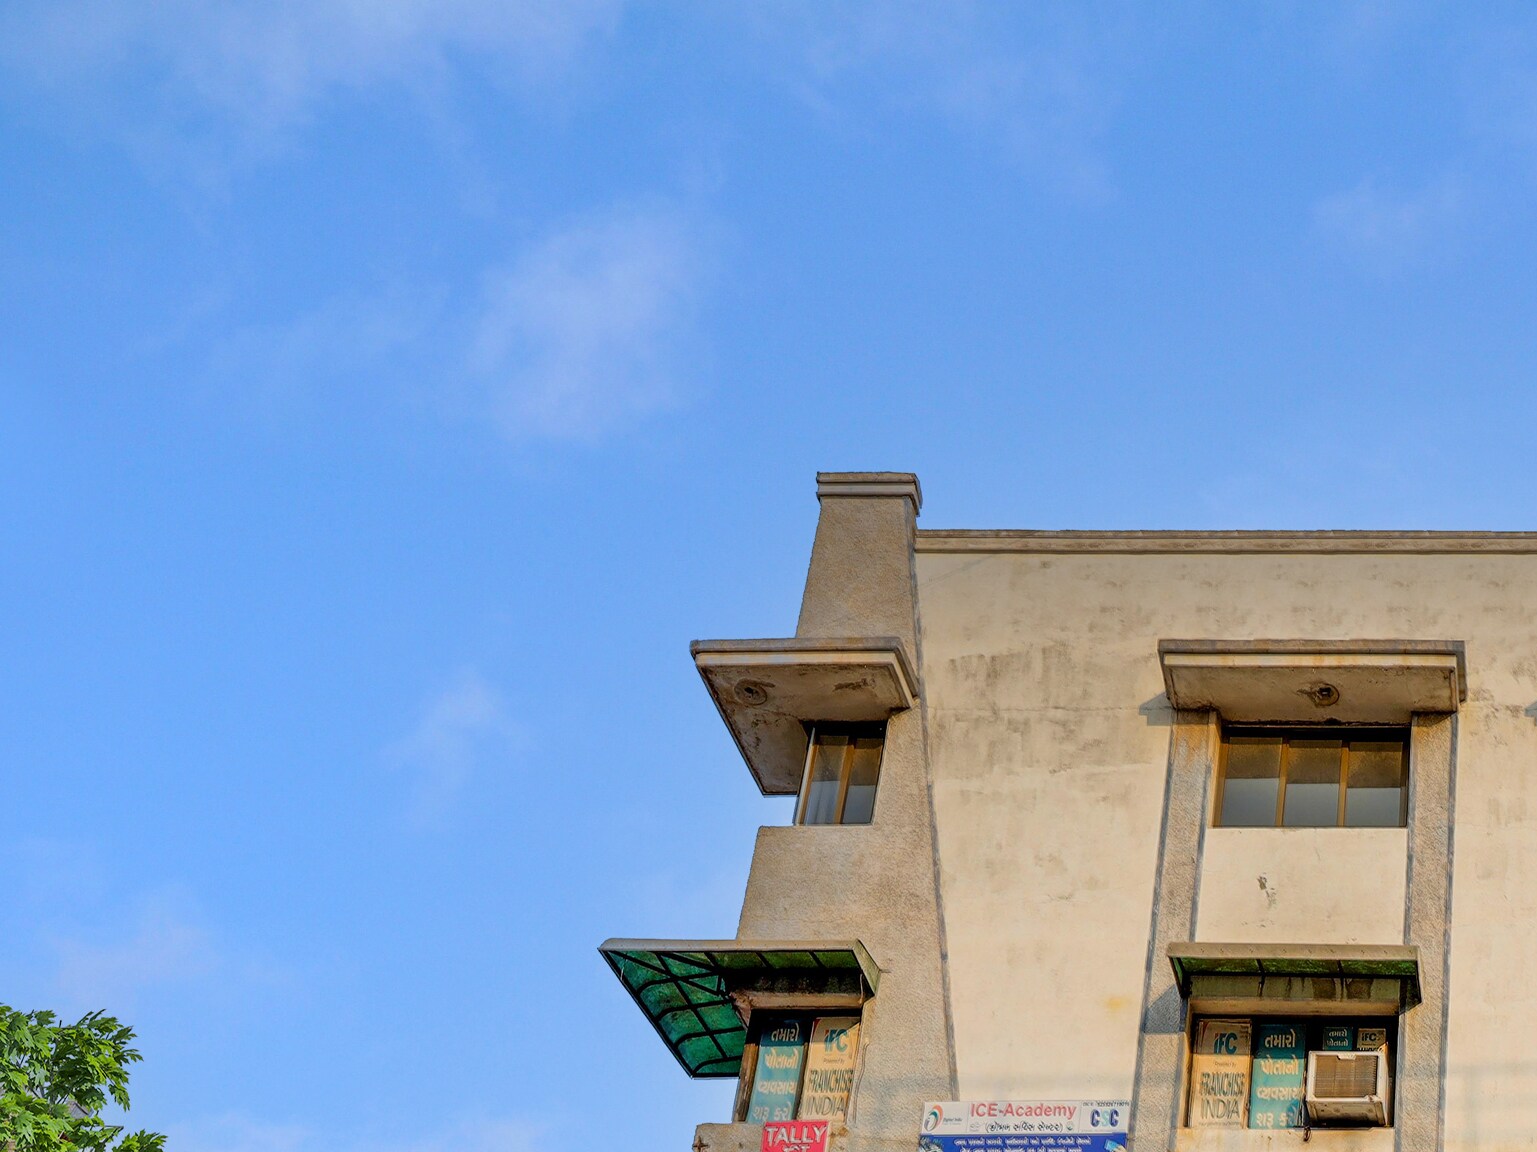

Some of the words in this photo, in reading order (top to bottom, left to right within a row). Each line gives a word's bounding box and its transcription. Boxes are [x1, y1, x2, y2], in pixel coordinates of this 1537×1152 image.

[771, 1023, 800, 1042] તમારો
[1264, 1029, 1296, 1048] તમારો
[765, 1049, 799, 1069] પોતાનો
[1260, 1054, 1299, 1075] પોતાનો
[805, 1096, 845, 1116] INDIA
[970, 1102, 1076, 1120] ICE-Academy
[1200, 1098, 1240, 1120] INDIA
[765, 1126, 827, 1146] TALLY
